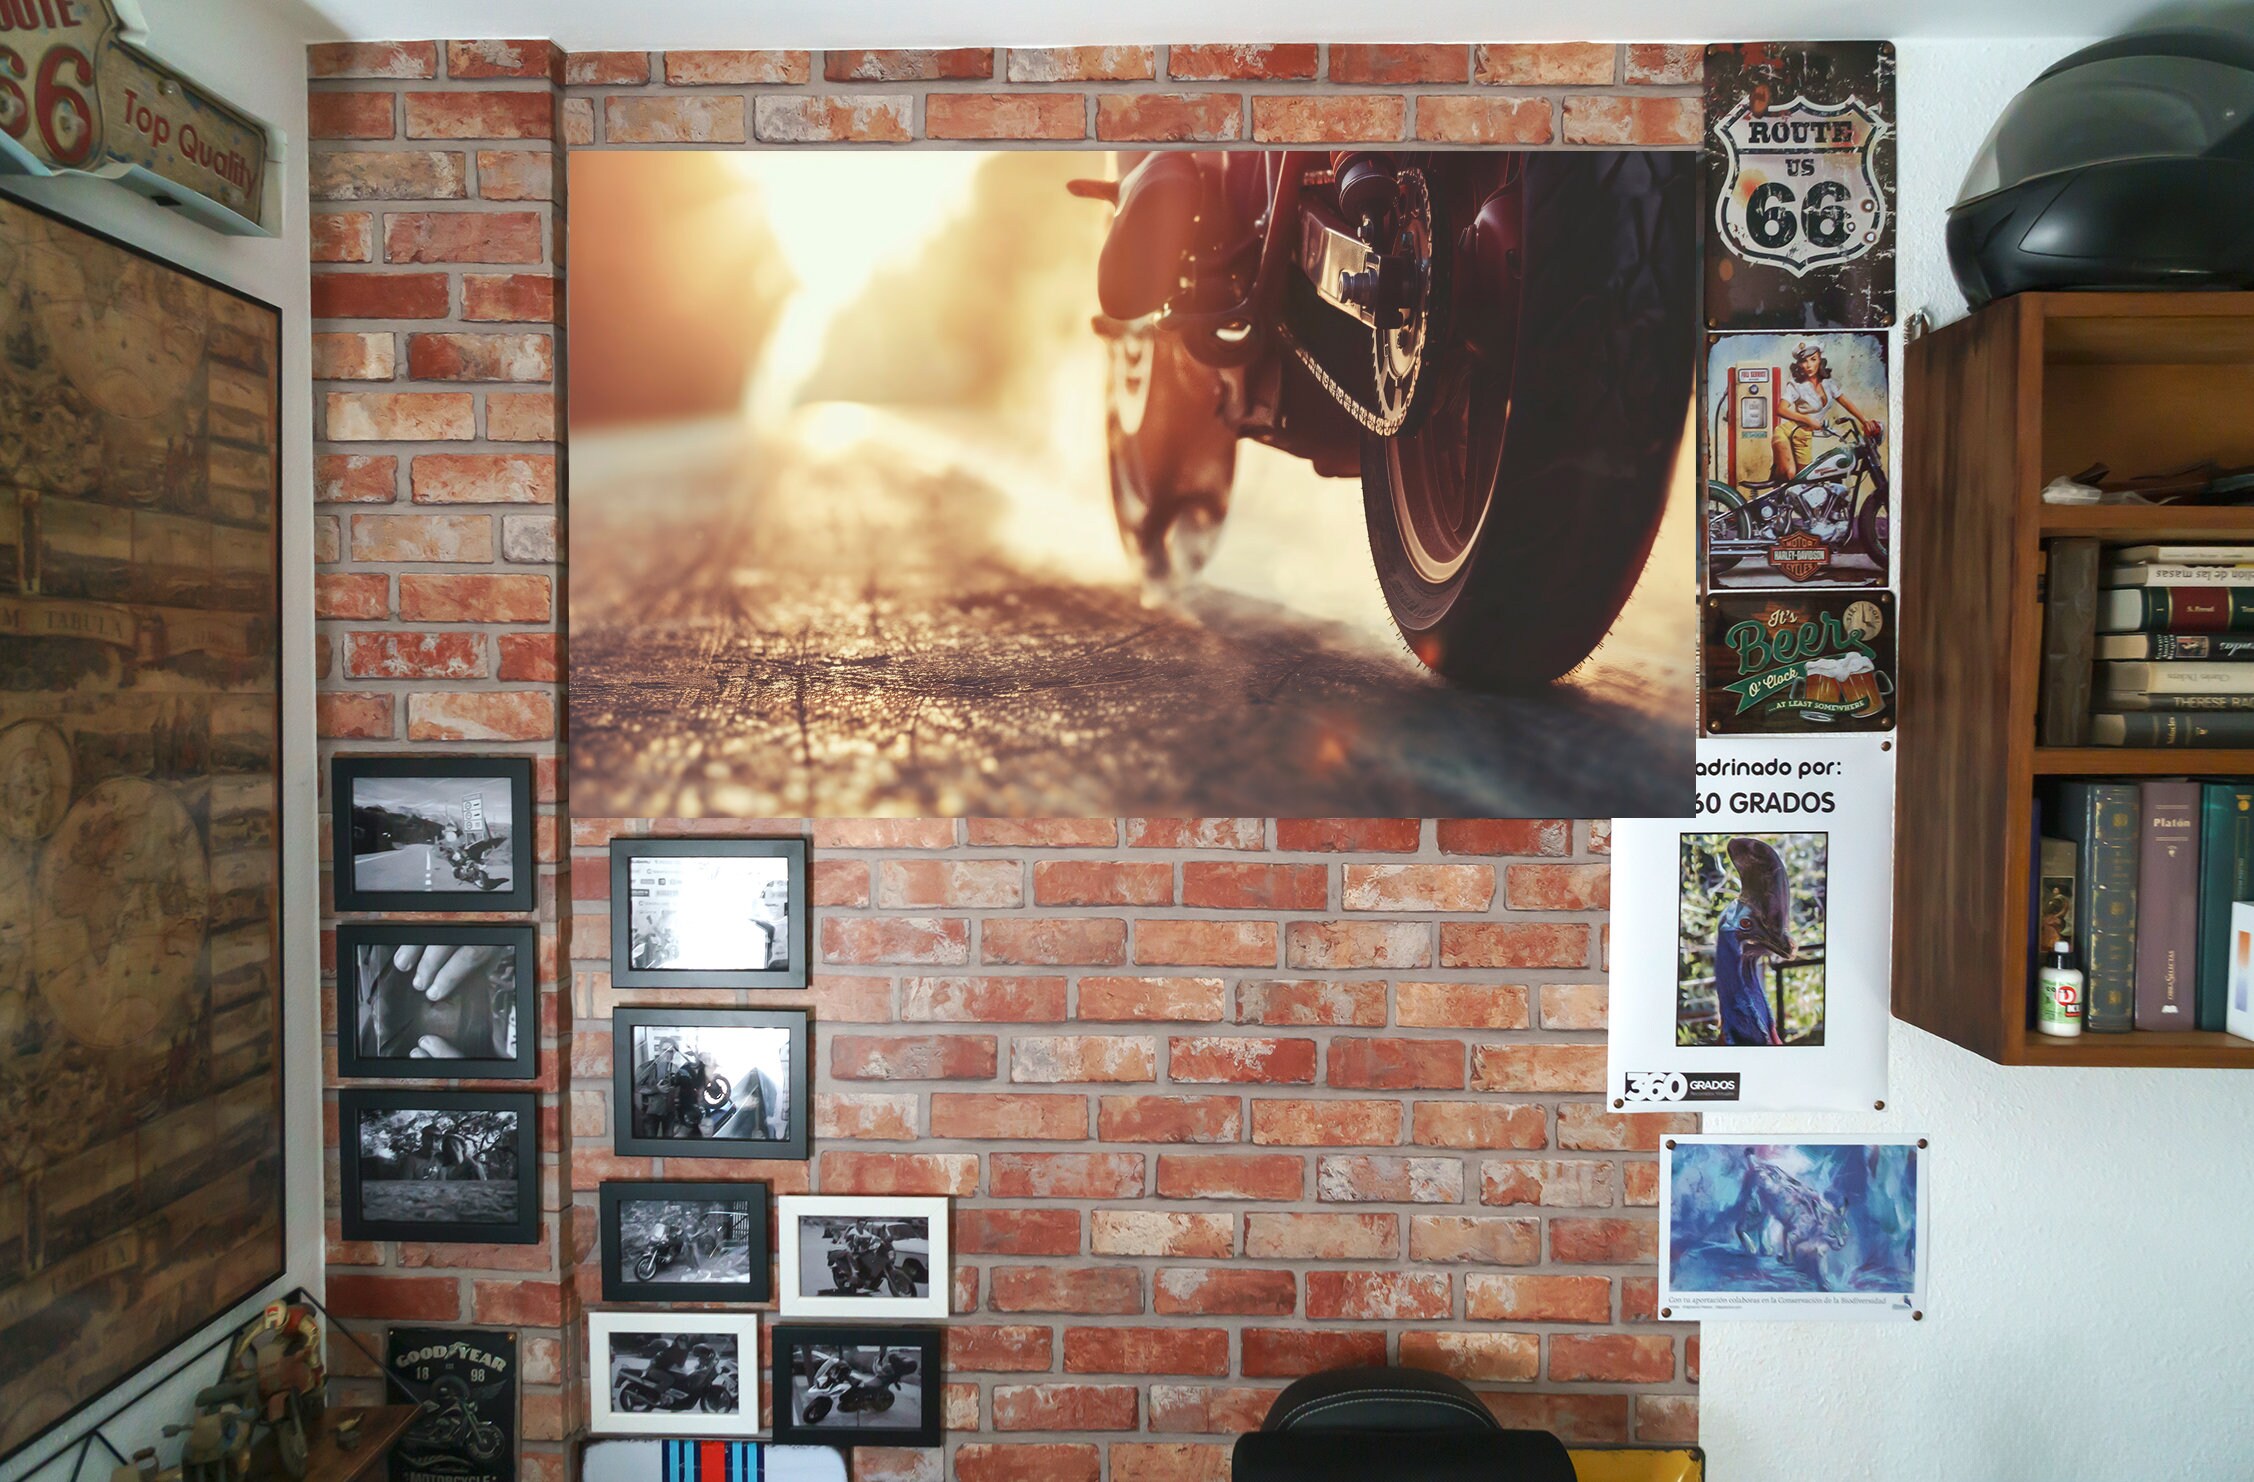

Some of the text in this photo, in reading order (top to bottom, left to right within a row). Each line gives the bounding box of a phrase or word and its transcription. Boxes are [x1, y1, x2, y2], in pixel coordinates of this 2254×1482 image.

[1748, 121, 1853, 144] ROUTE
[124, 88, 258, 200] Top Quality
[1785, 158, 1815, 177] US
[1745, 180, 1853, 249] 66
[1774, 550, 1825, 561] HARLEY-DAVIDSON
[1786, 563, 1814, 577] CYCLES
[2155, 569, 2193, 580] masas
[1768, 608, 1799, 628] It's
[1725, 611, 1877, 675] Beer
[1788, 700, 1812, 709] LEAST
[1814, 700, 1866, 713] SOMEWHERE
[1798, 761, 1842, 780] por:
[1729, 791, 1836, 814] GRADOS
[2153, 817, 2191, 829] Platón
[1625, 1072, 1736, 1101] 360 GRADOS
[395, 1340, 507, 1373] GOODYEAR
[416, 1366, 430, 1381] 18
[470, 1368, 486, 1382] 98
